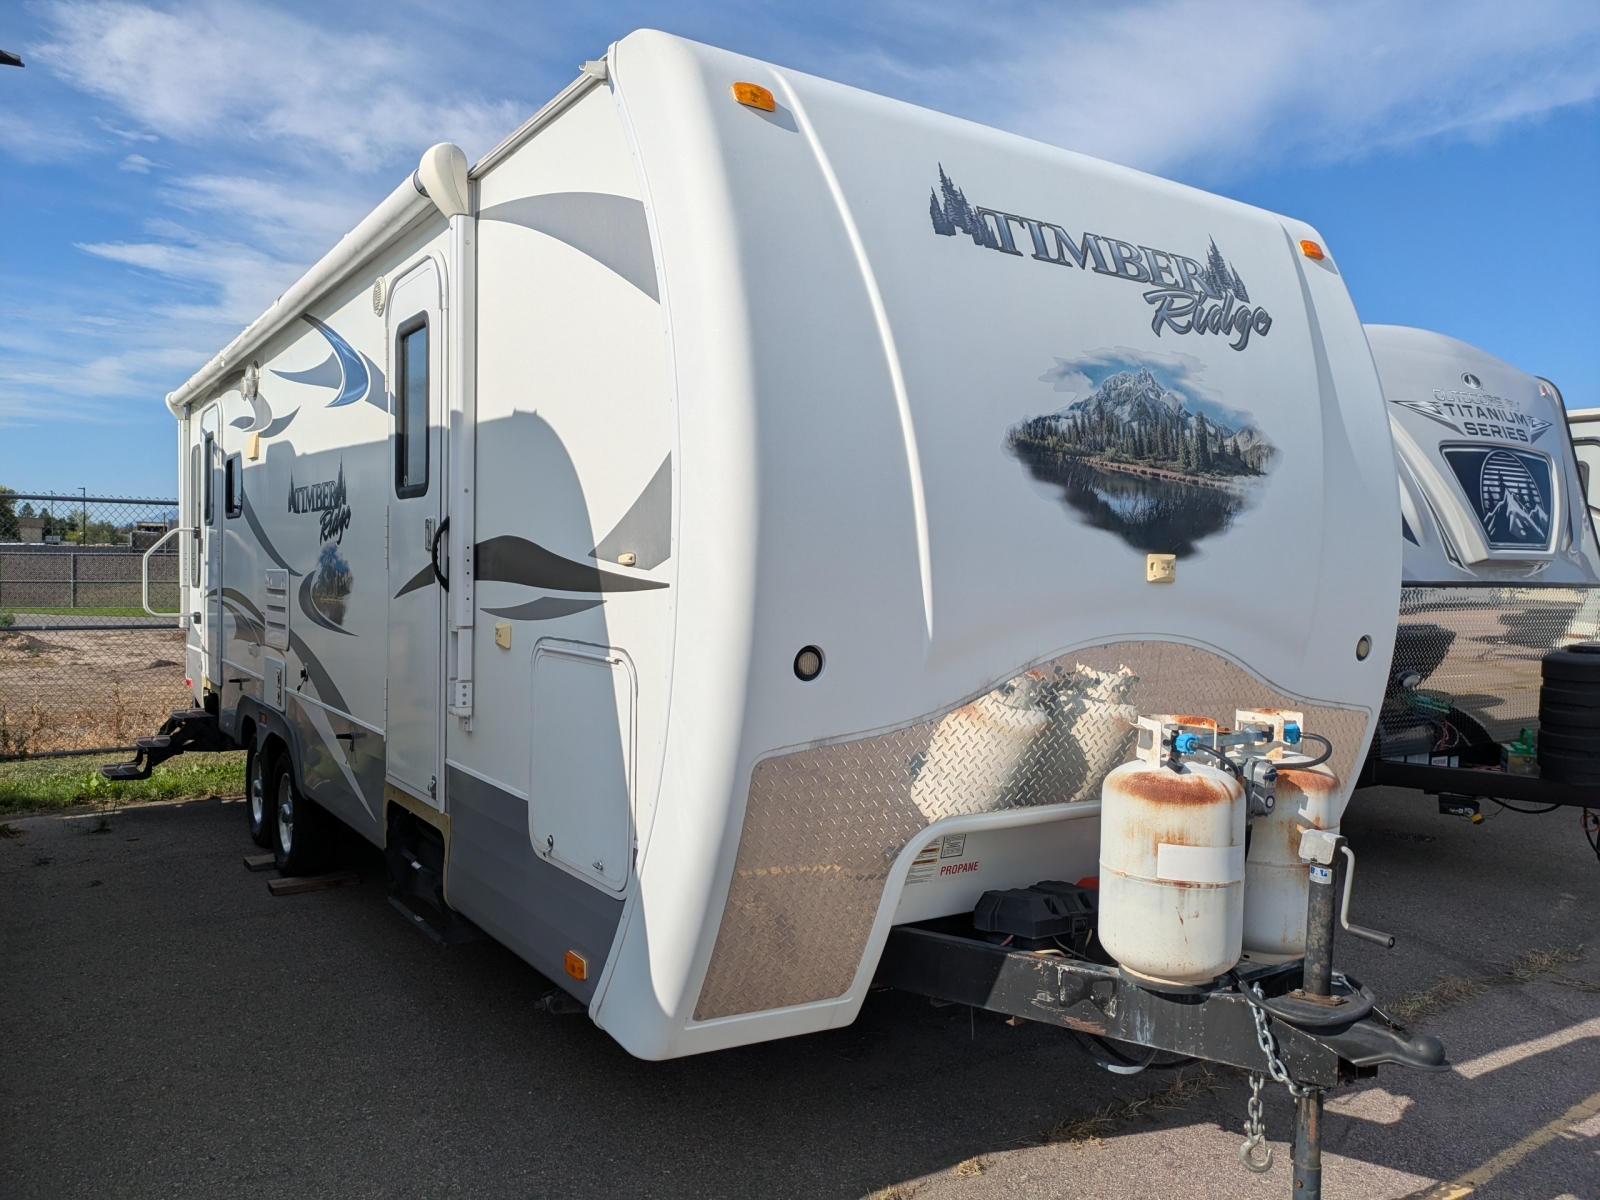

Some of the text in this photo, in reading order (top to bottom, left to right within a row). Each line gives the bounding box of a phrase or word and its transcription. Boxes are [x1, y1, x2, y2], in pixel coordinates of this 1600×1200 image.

[976, 205, 1222, 300] TIMBER
[1143, 287, 1273, 352] Ridge
[1443, 402, 1529, 427] TITANIUM
[1464, 422, 1529, 442] SERIES
[294, 480, 339, 514] TIMBER
[940, 861, 979, 876] PROPANE
